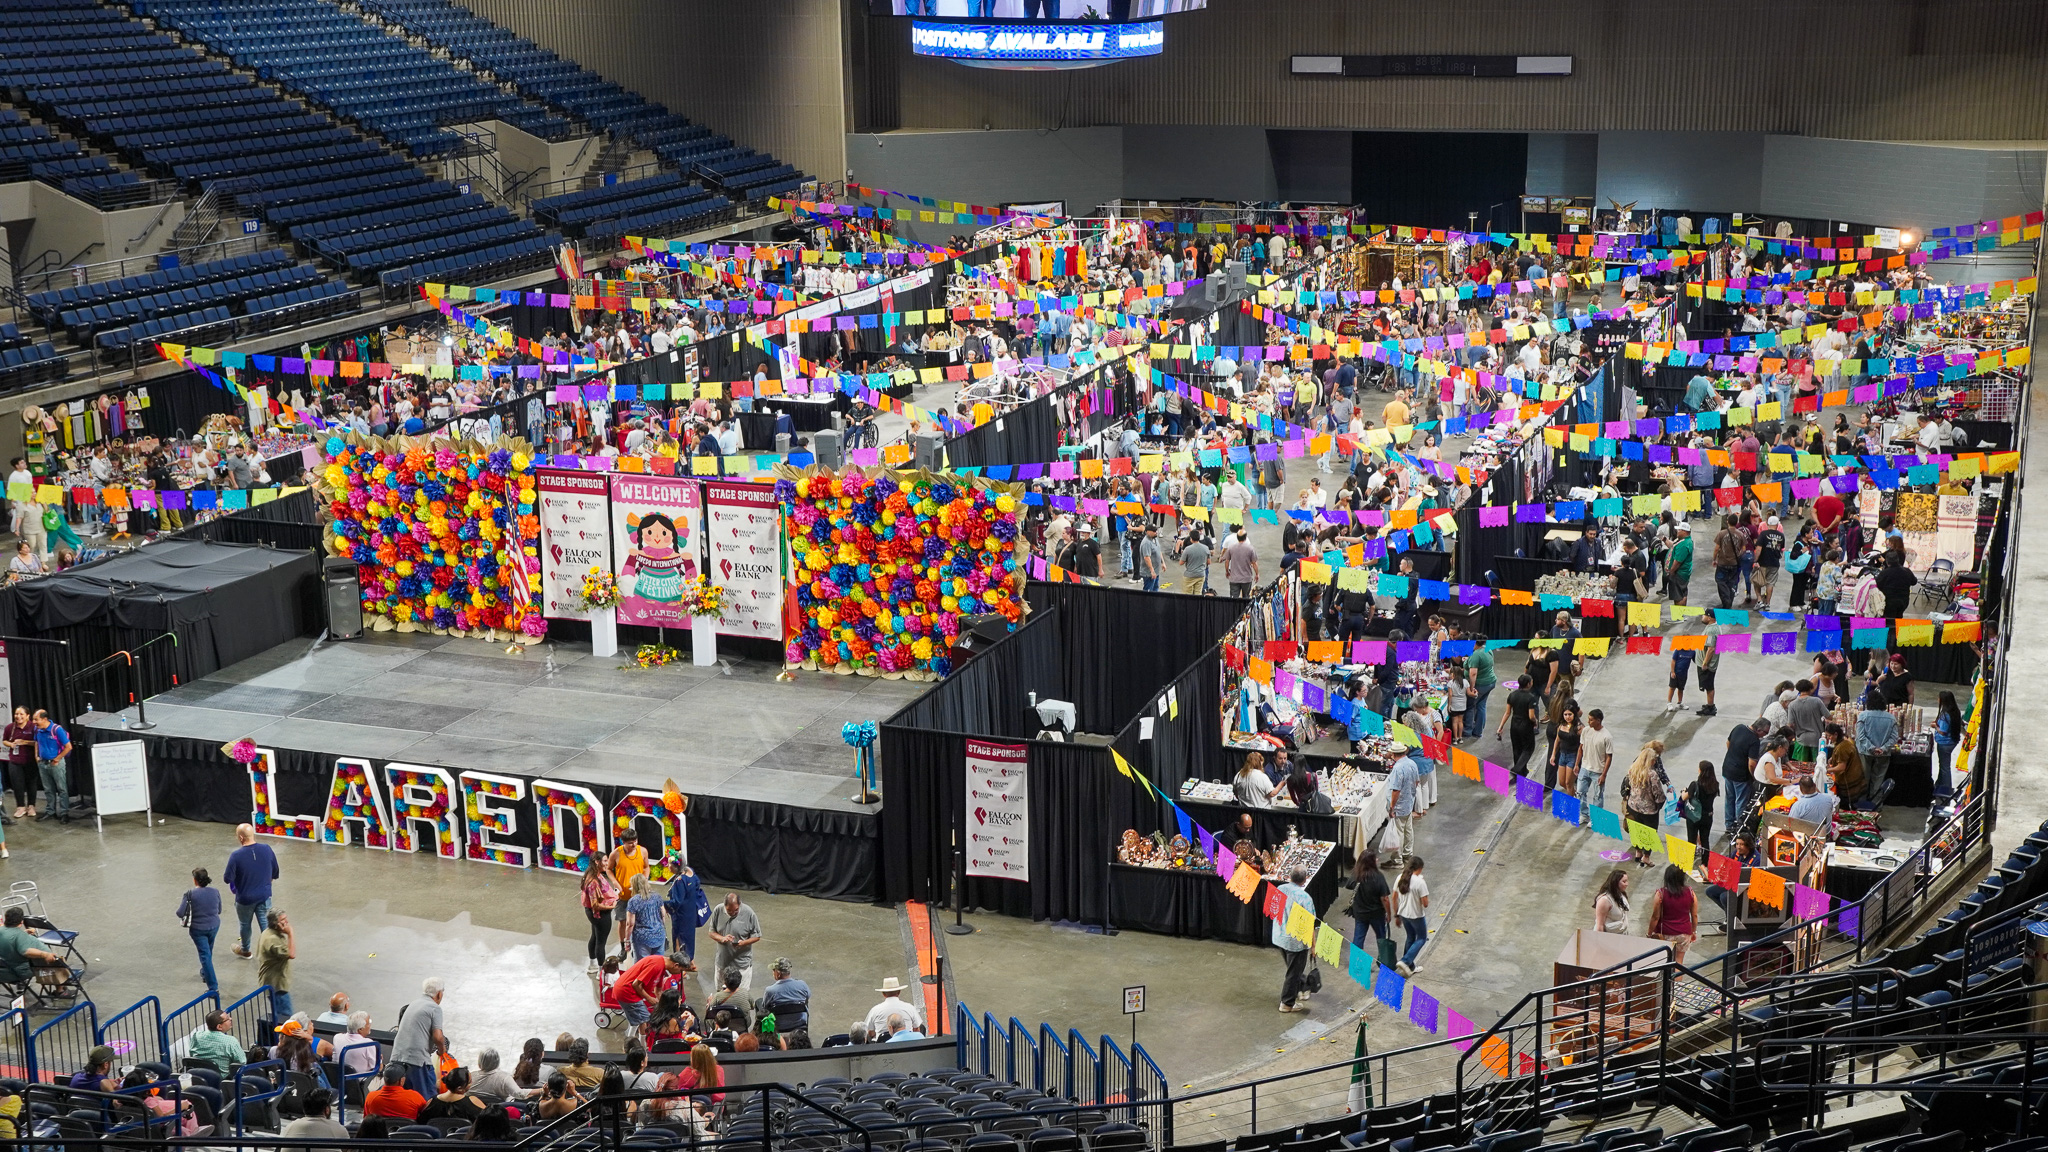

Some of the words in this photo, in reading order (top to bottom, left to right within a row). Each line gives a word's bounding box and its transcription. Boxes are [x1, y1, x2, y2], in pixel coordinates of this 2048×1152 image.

[917, 28, 988, 50] POSITIONS
[990, 32, 1106, 50] AVAILABLE
[245, 220, 258, 232] 119
[540, 476, 566, 486] STAGE
[567, 477, 604, 489] SPONSOR
[620, 483, 691, 503] WELCOME
[710, 488, 736, 500] STAGE
[738, 490, 775, 502] SPONSOR
[565, 548, 602, 558] FALCON
[566, 556, 590, 564] BANK
[735, 563, 773, 573] FALCON
[640, 572, 660, 585] SISTER
[661, 574, 681, 586] CITIES
[735, 571, 761, 580] BANK
[642, 582, 682, 598] FESTIVAL
[968, 744, 991, 755] STAGE
[992, 748, 1026, 758] SPONSOR
[989, 811, 1022, 821] FALCON
[1982, 954, 1993, 963] ROW
